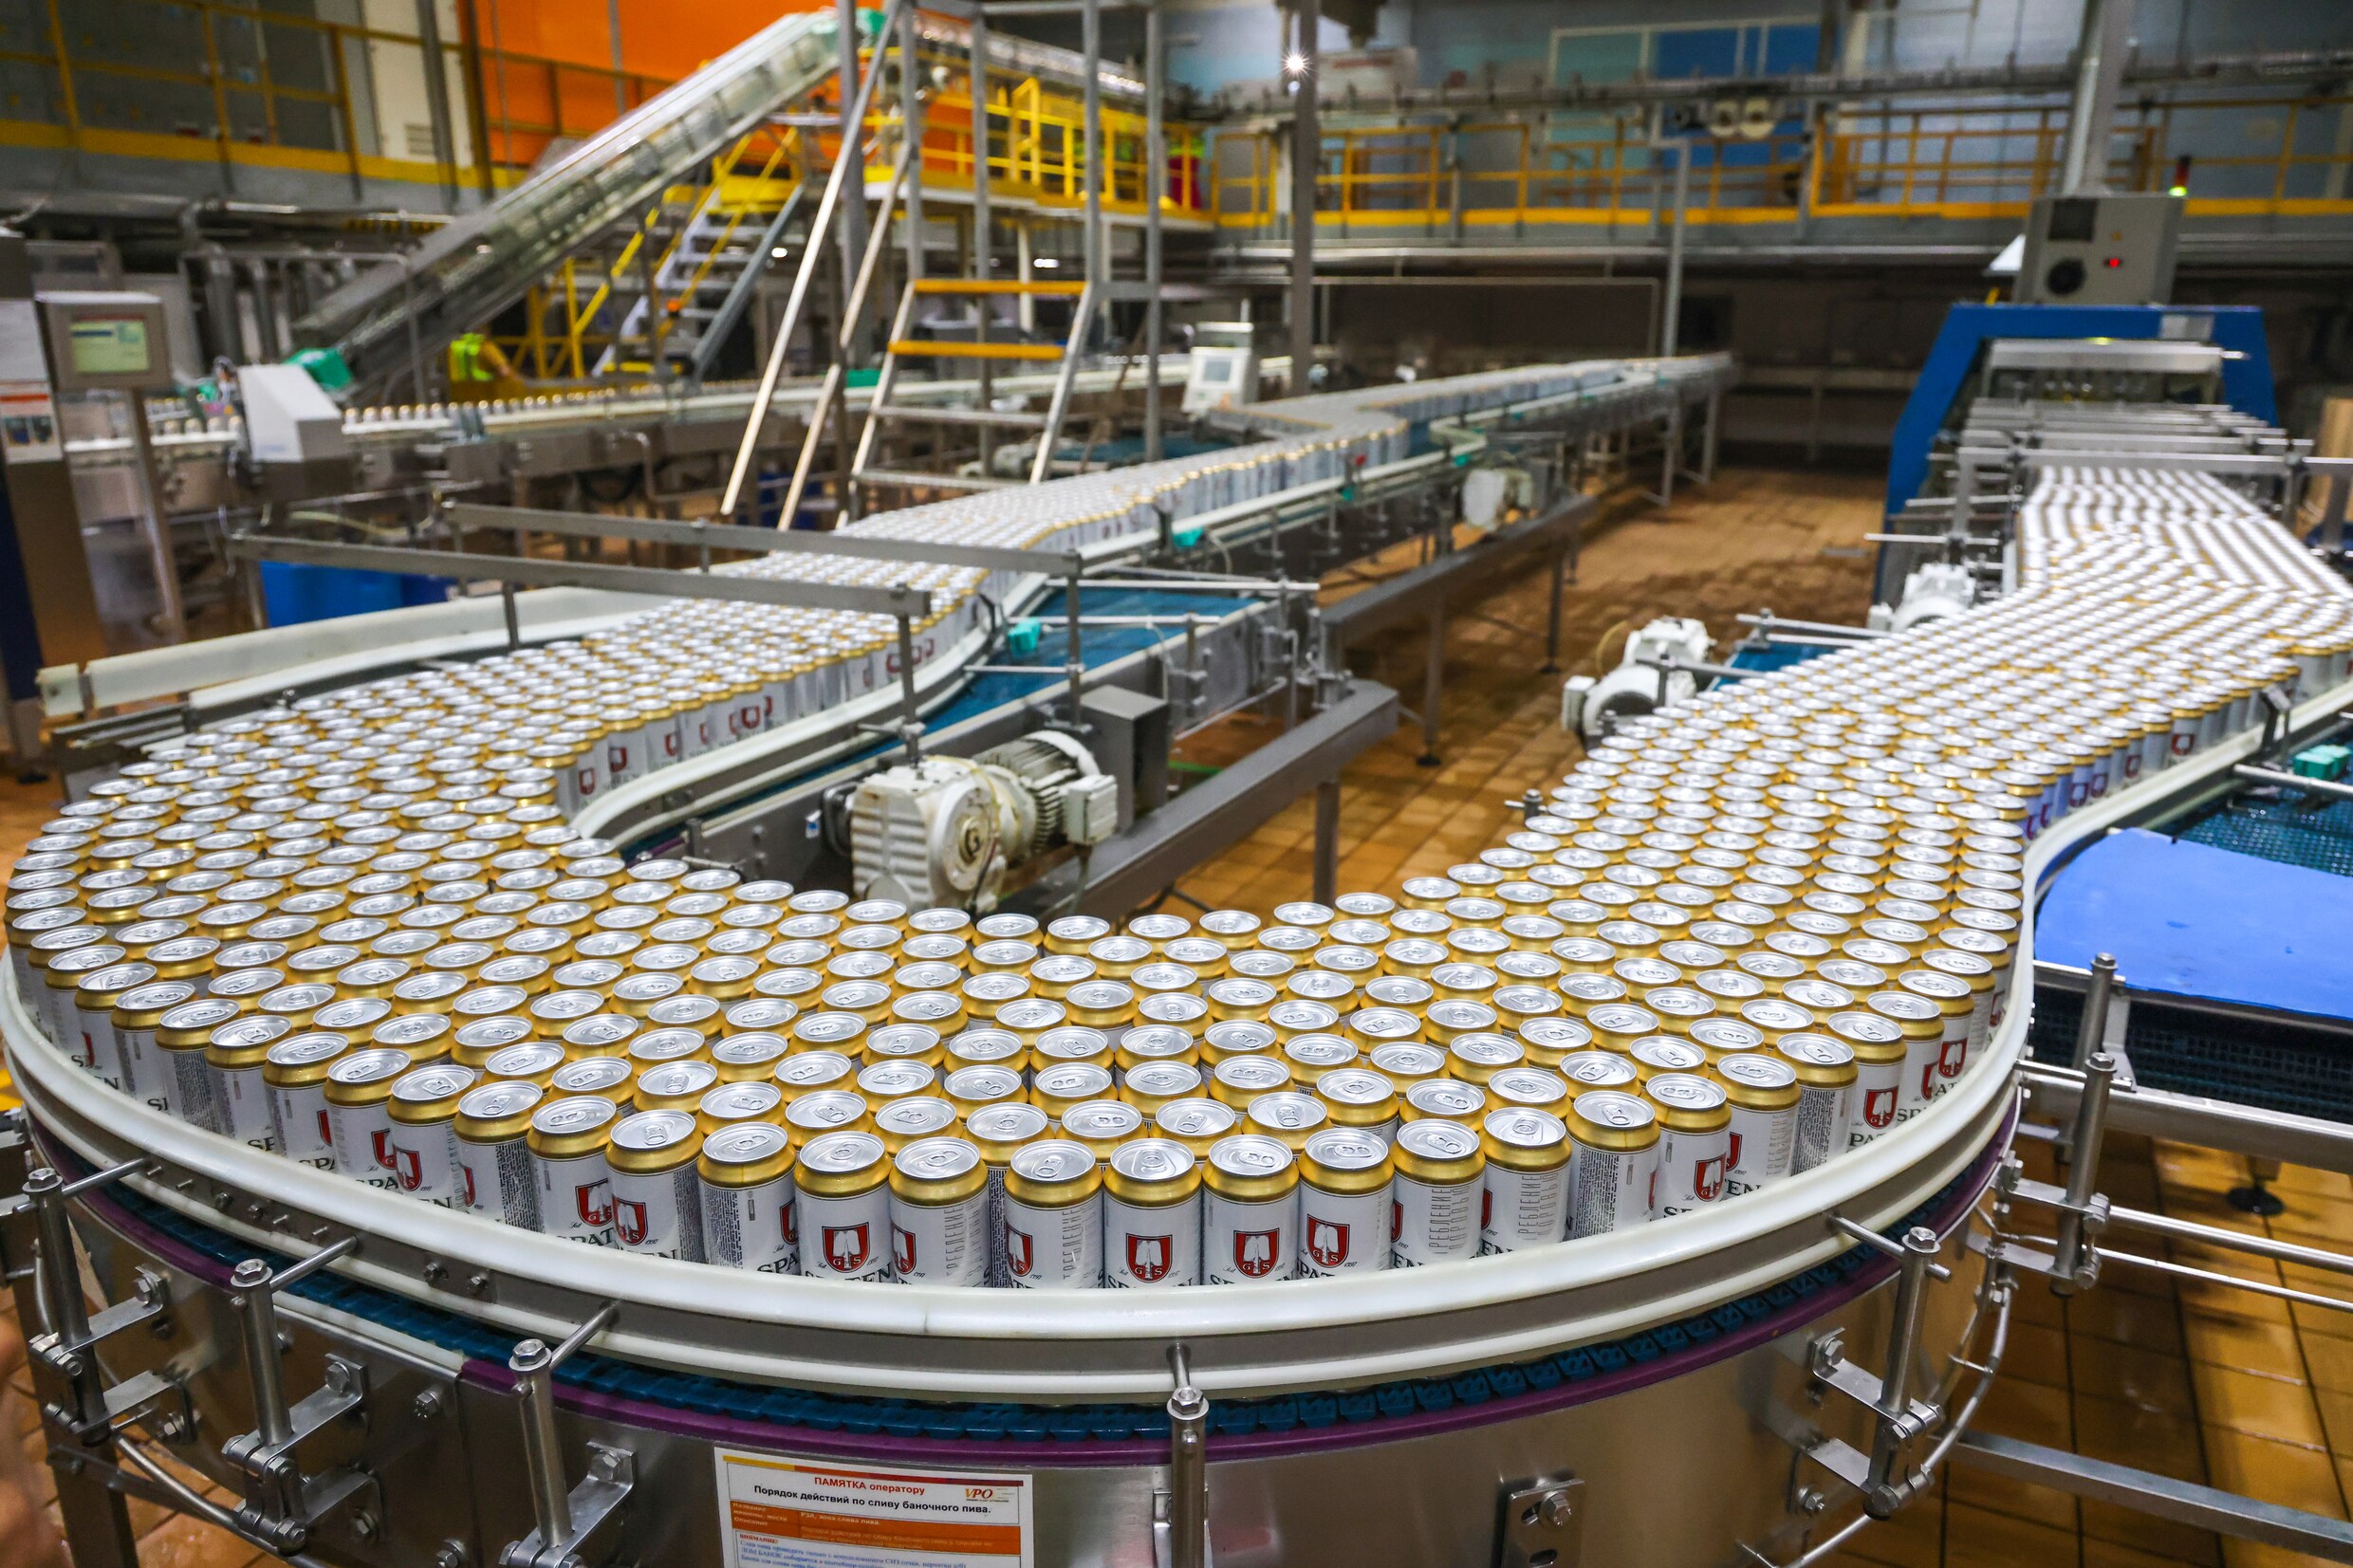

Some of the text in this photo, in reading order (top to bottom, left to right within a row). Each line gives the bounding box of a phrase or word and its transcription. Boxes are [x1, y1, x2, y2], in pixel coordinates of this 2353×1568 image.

[814, 1477, 925, 1496] ПАМЯТКА оператору
[964, 1487, 993, 1500] VPO
[754, 1485, 991, 1514] Порядок действий по сливу баночного пива.
